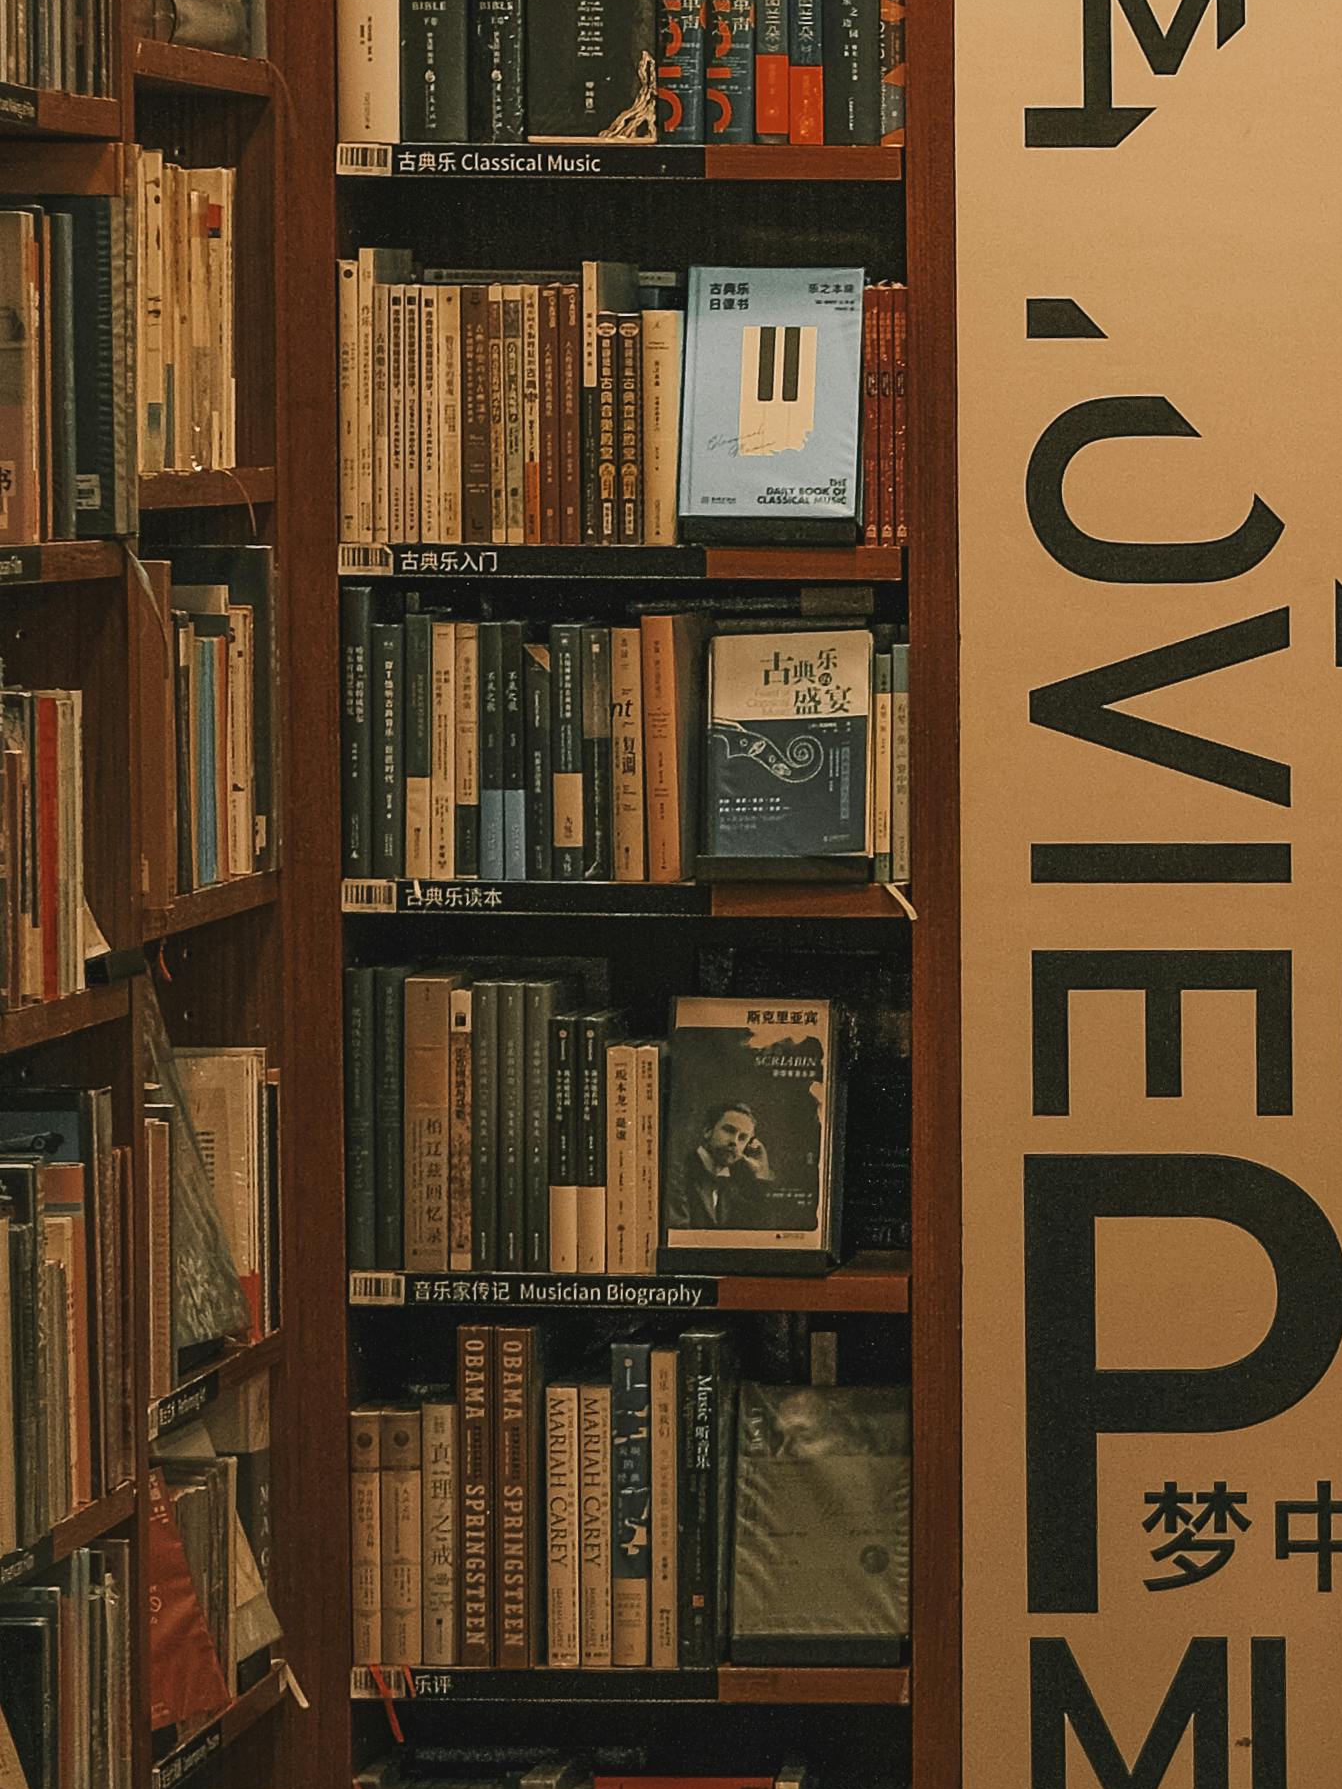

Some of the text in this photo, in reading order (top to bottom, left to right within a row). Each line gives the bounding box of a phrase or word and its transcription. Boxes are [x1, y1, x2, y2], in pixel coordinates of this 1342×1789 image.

[398, 152, 601, 174] 古典乐 Classical Music
[400, 552, 498, 574] 古典乐入门
[404, 888, 503, 910] 古典乐读本
[414, 1281, 702, 1307] 音乐家传记 Musician Biography
[697, 1374, 713, 1423] Music
[465, 1338, 490, 1645] OBAMA SPRINGSTEEN
[503, 1339, 524, 1647] OBAMA SPRINGSTEEN
[549, 1397, 569, 1569] MARIAH CAREY
[583, 1397, 602, 1569] MARIAH CAREY
[415, 1675, 453, 1695] 乐评
